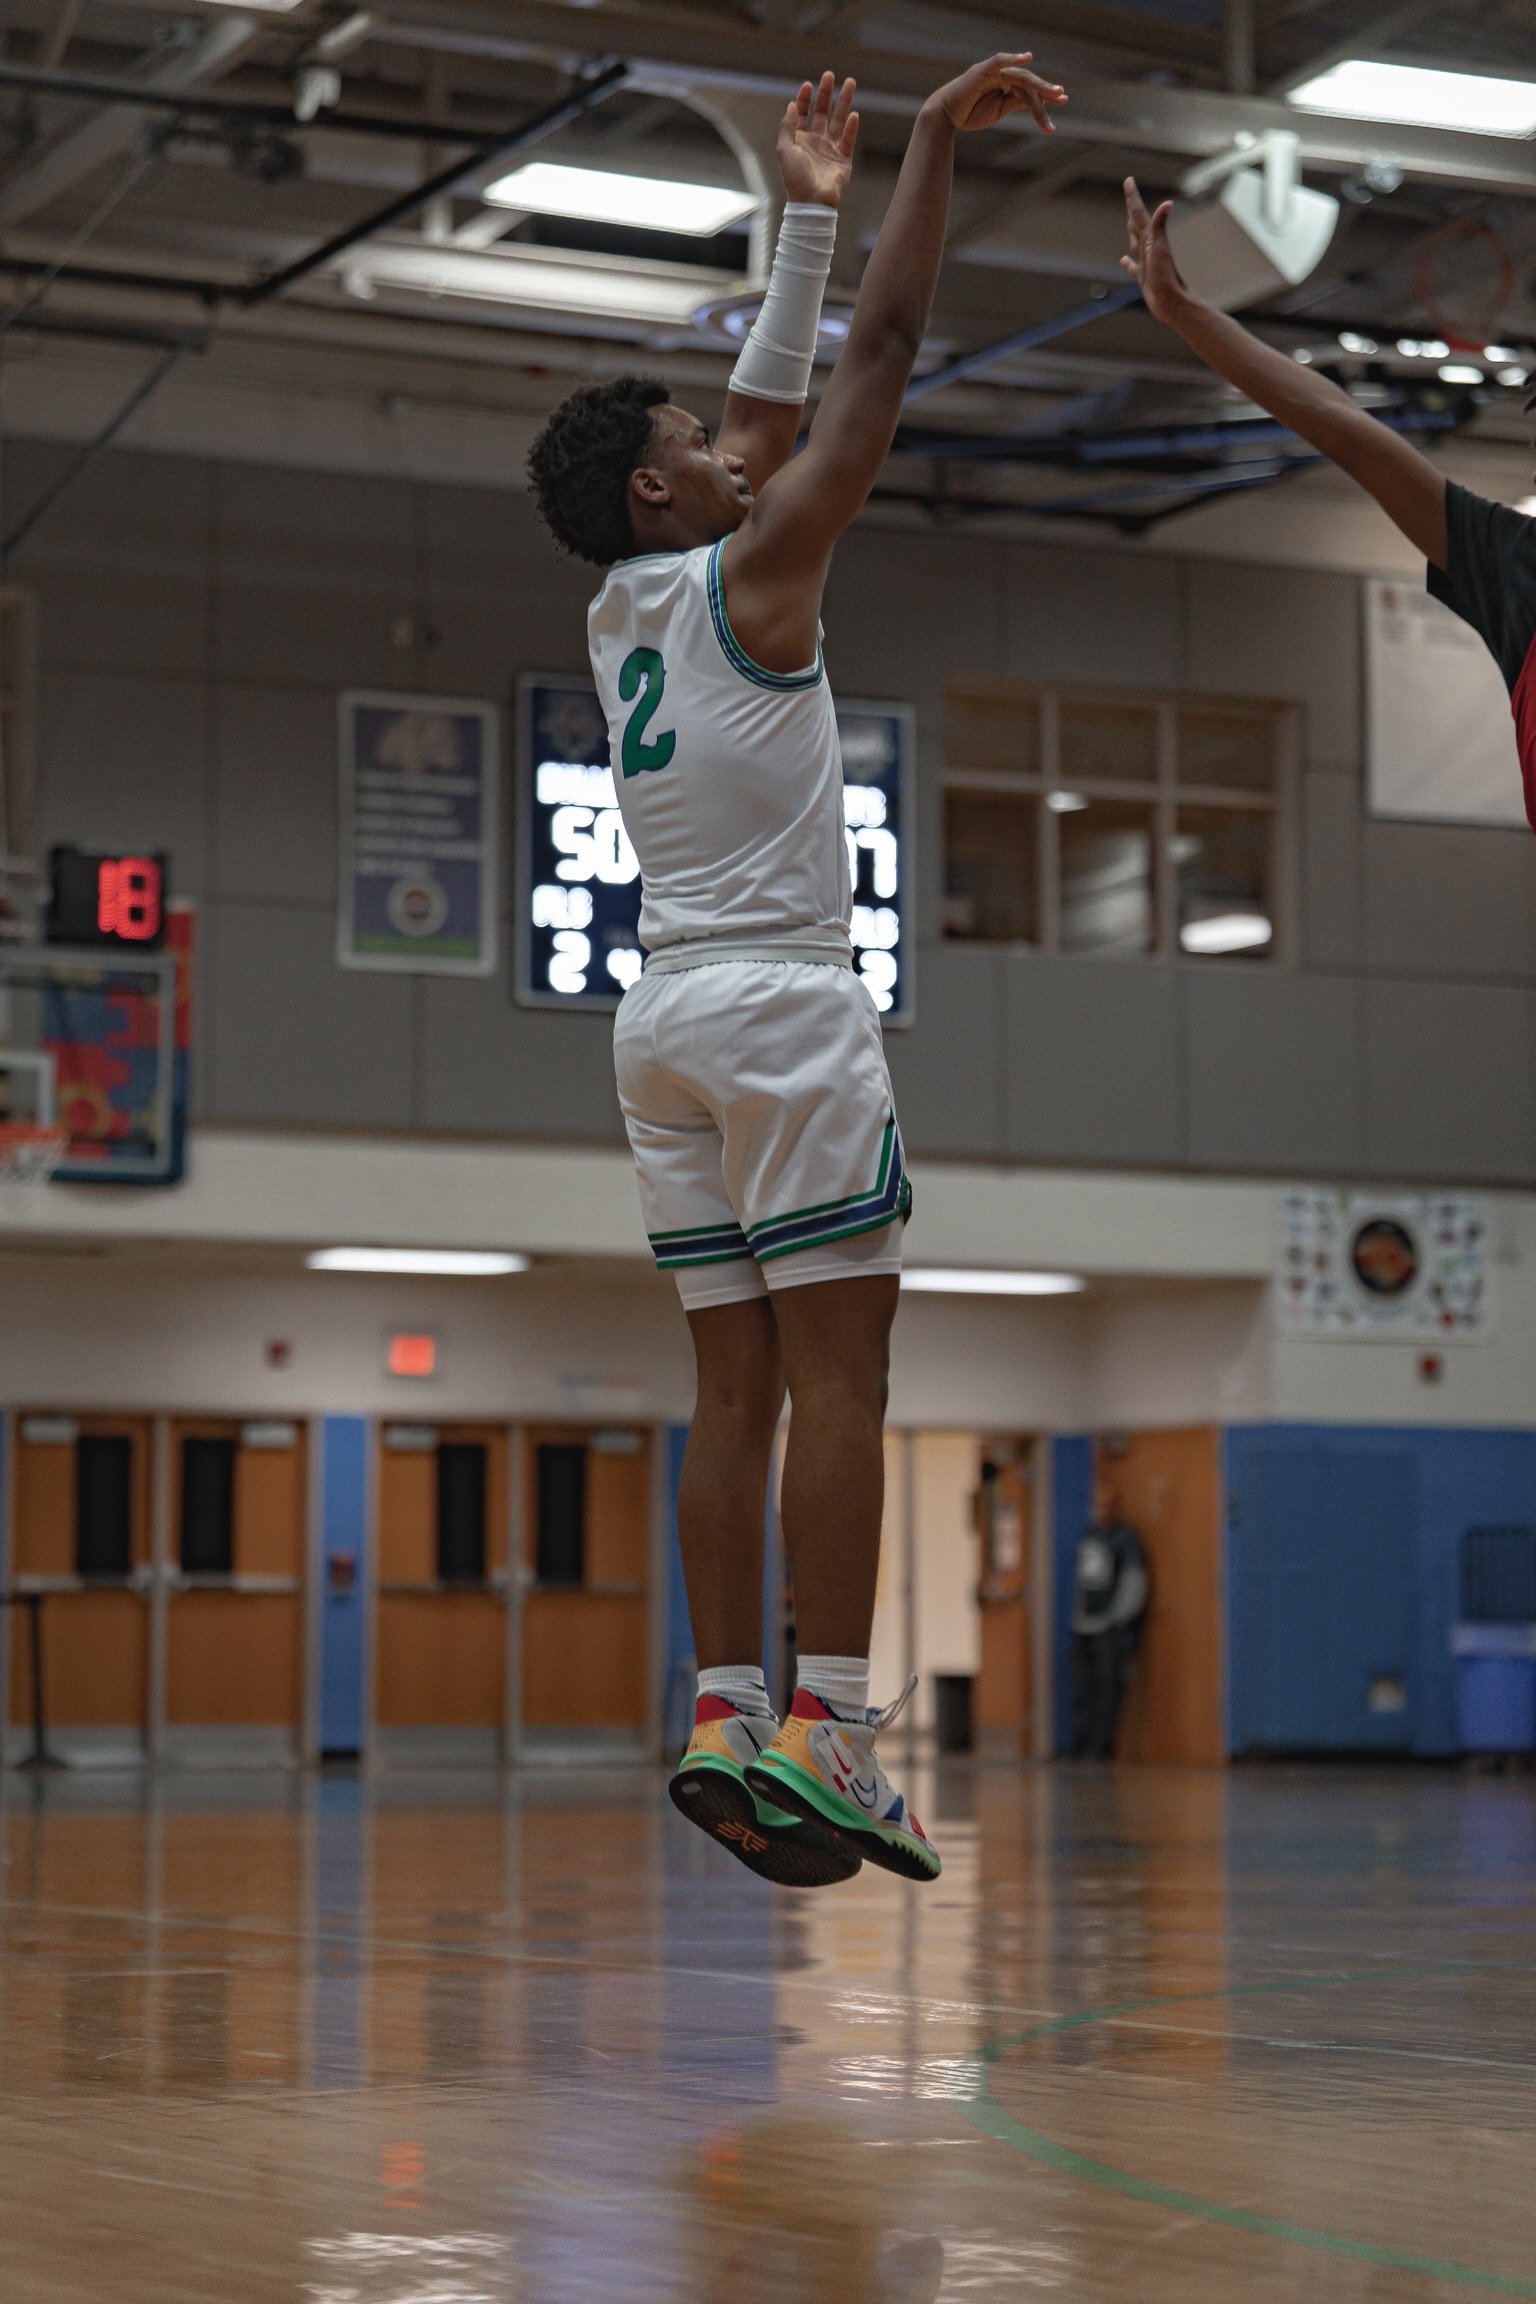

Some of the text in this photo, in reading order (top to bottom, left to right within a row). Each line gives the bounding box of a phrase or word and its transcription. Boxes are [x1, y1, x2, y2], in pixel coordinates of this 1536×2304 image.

[618, 646, 676, 779] 2
[551, 806, 640, 884] 50
[844, 827, 898, 899] 7
[98, 857, 161, 940] 18
[549, 930, 591, 993] 2
